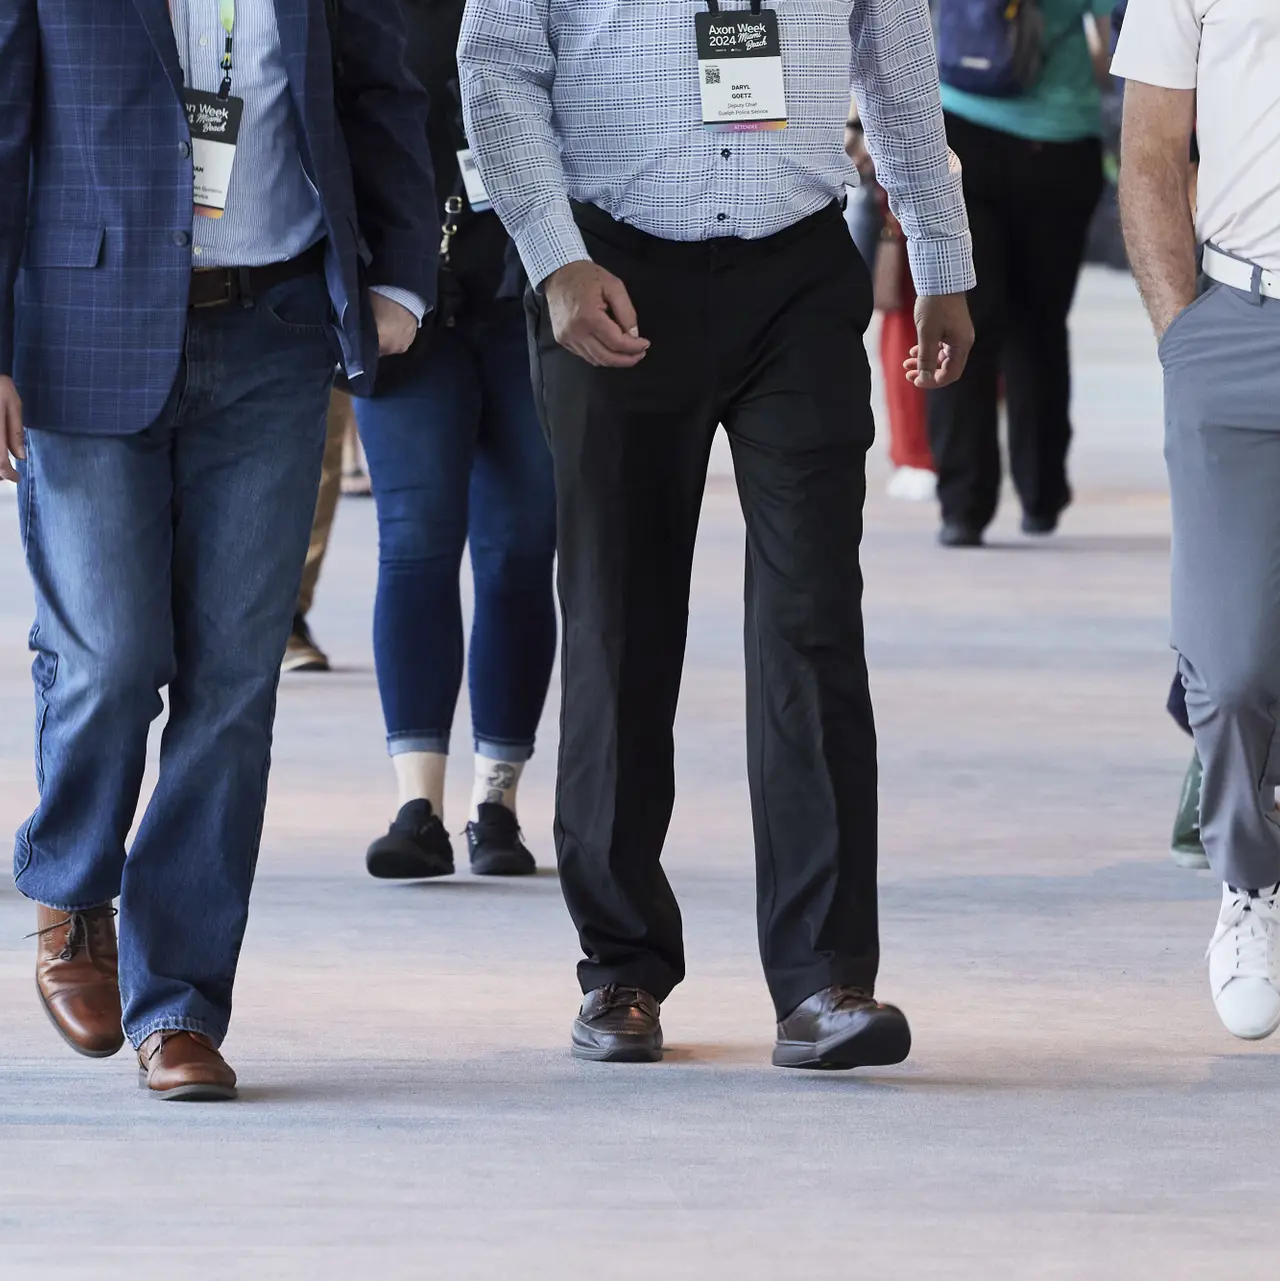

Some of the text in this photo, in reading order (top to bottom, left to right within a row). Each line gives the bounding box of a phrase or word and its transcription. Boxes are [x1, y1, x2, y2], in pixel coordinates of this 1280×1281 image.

[709, 22, 767, 36] Axon Week
[709, 31, 762, 47] 2024 Miami
[745, 36, 768, 51] Beach
[731, 92, 753, 100] GOETZ
[199, 103, 229, 119] Week
[202, 121, 227, 133] Beach
